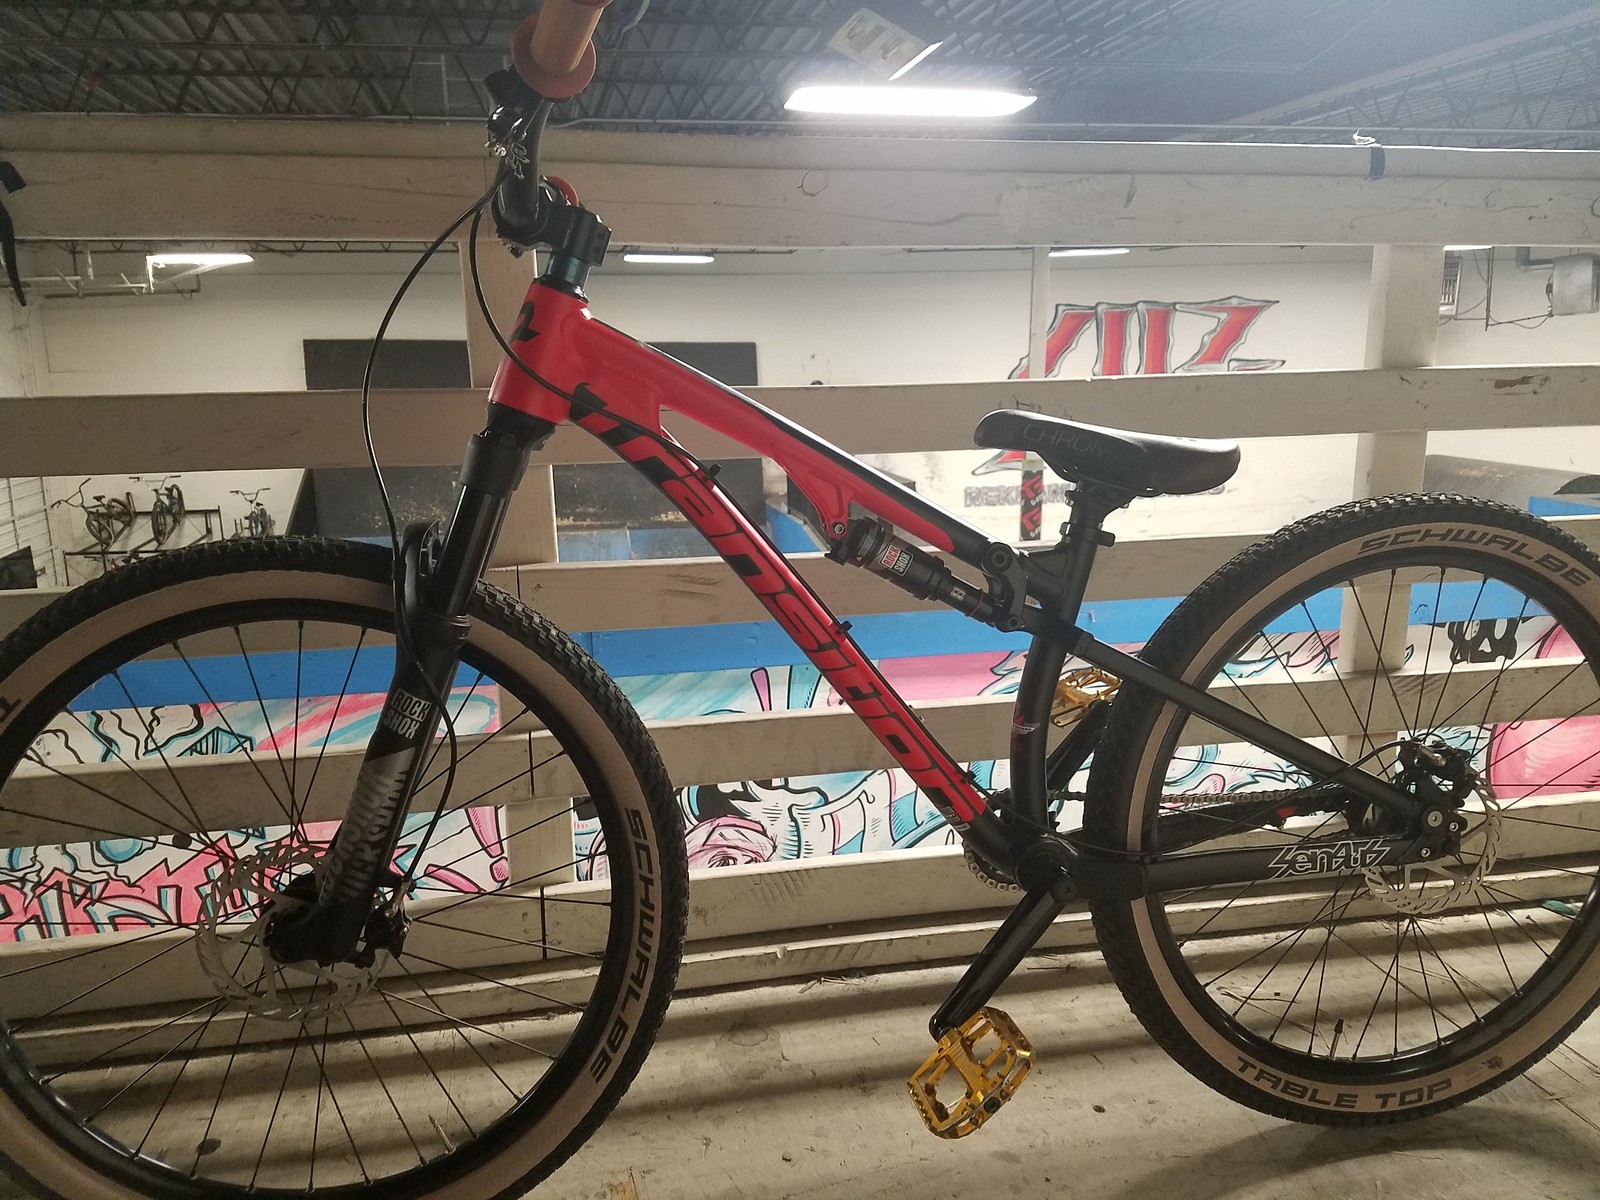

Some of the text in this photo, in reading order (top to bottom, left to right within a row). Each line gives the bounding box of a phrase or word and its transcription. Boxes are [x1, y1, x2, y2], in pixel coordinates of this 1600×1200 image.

[882, 544, 901, 567] ROCK
[894, 552, 912, 573] SHOX
[1358, 529, 1592, 587] SCHWALBE
[392, 689, 431, 722] ROCK
[384, 708, 421, 740] SHOX
[590, 806, 655, 1083] SCHWALBE
[1237, 1056, 1452, 1109] TABLE TOP
